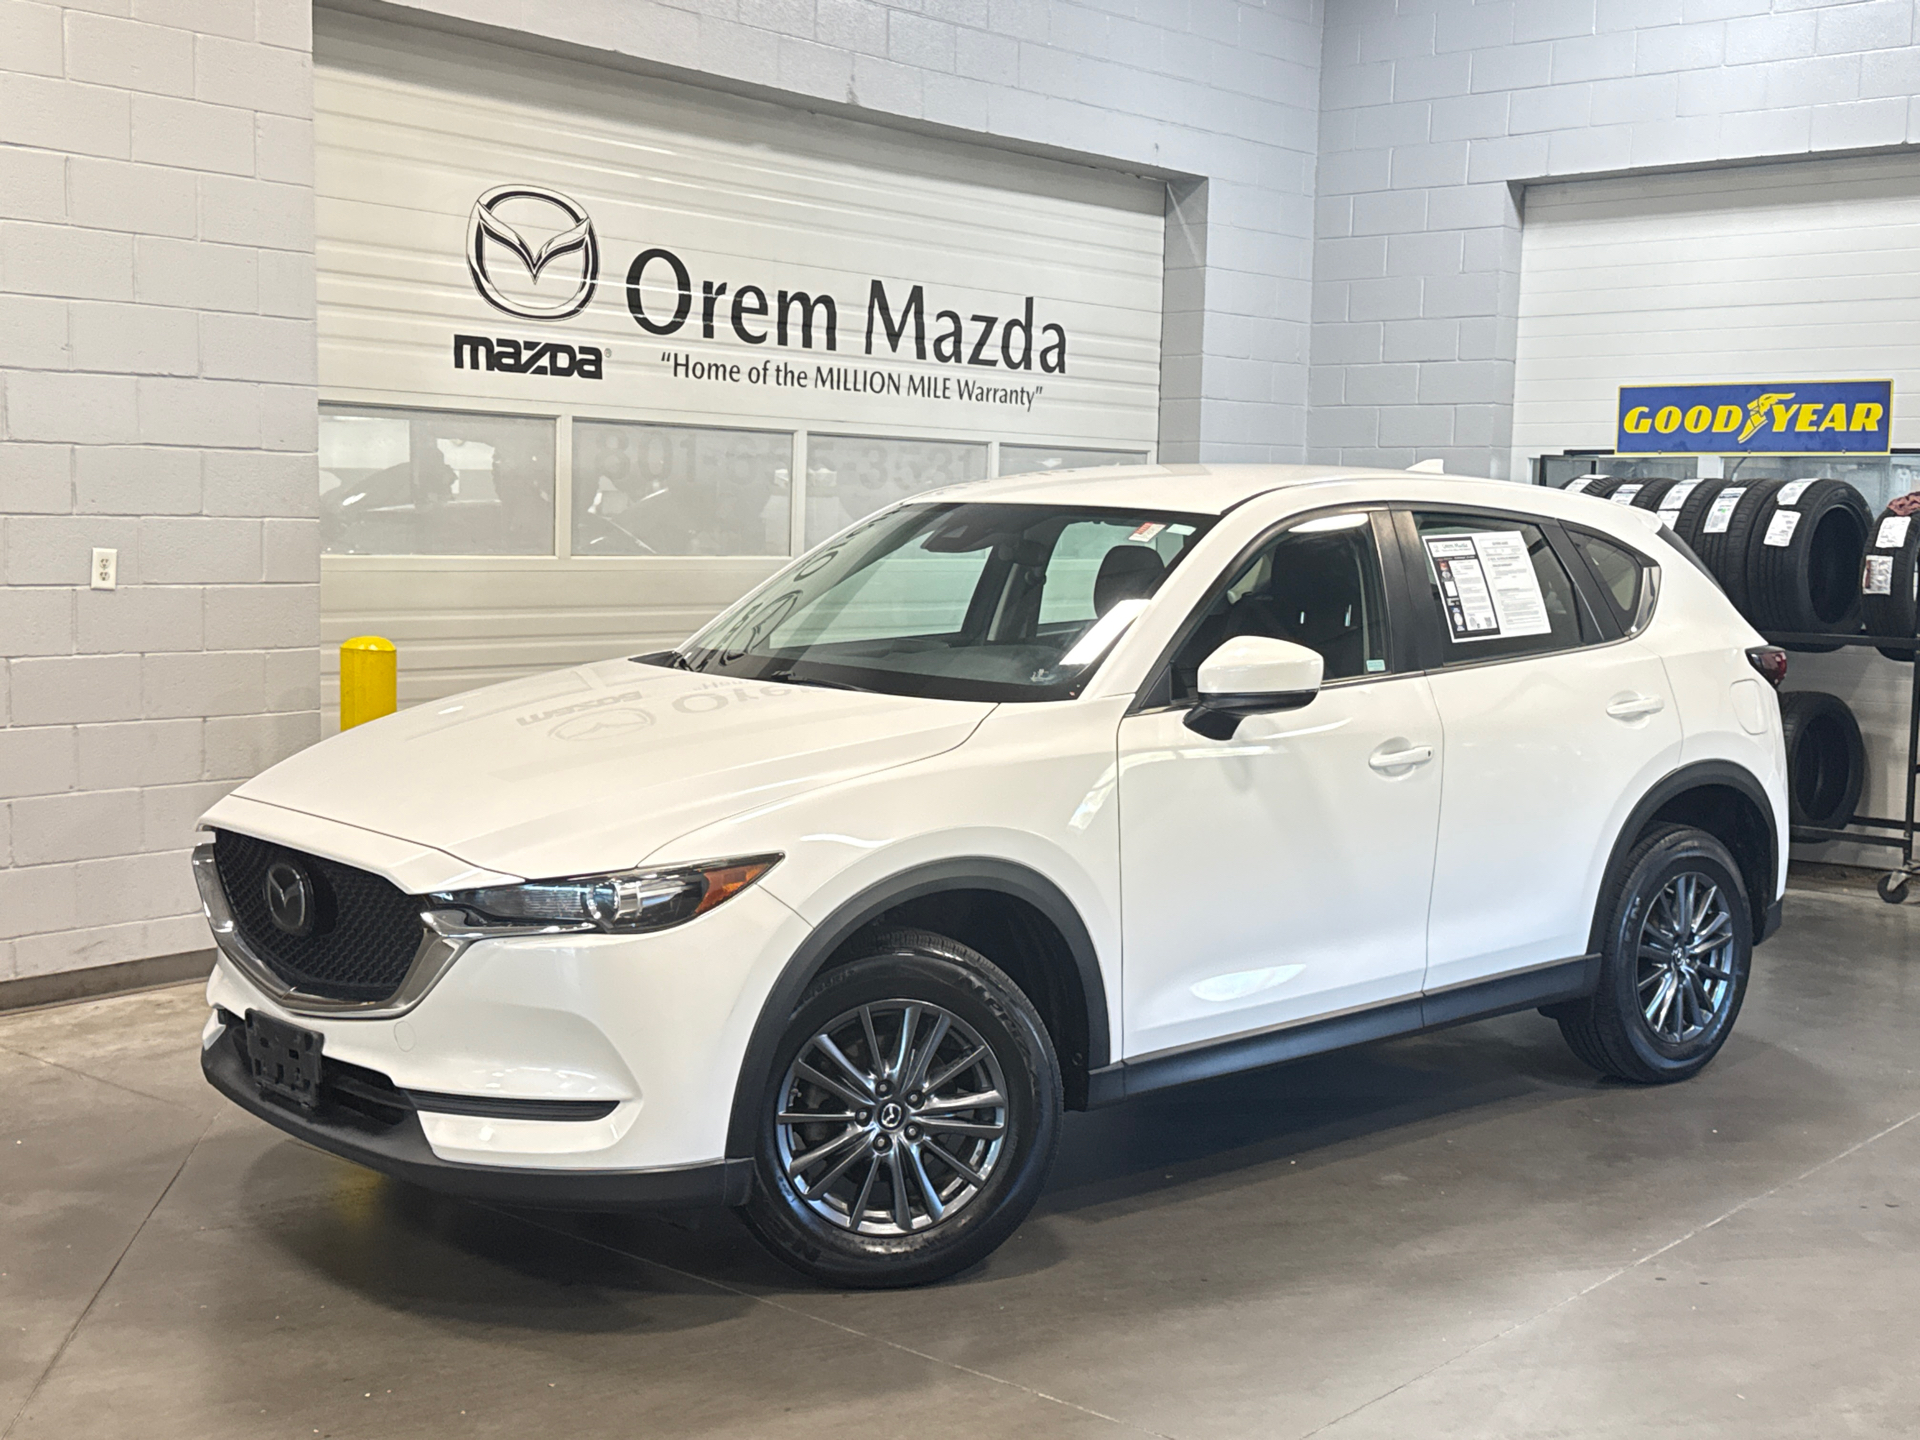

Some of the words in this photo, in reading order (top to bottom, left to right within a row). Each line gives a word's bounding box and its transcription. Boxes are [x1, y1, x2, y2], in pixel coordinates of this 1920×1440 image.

[626, 248, 837, 352] Orem
[865, 280, 1066, 375] Mazda
[747, 360, 771, 385] of
[775, 362, 808, 388] the
[814, 365, 901, 395] MILLION
[907, 374, 951, 400] MILE
